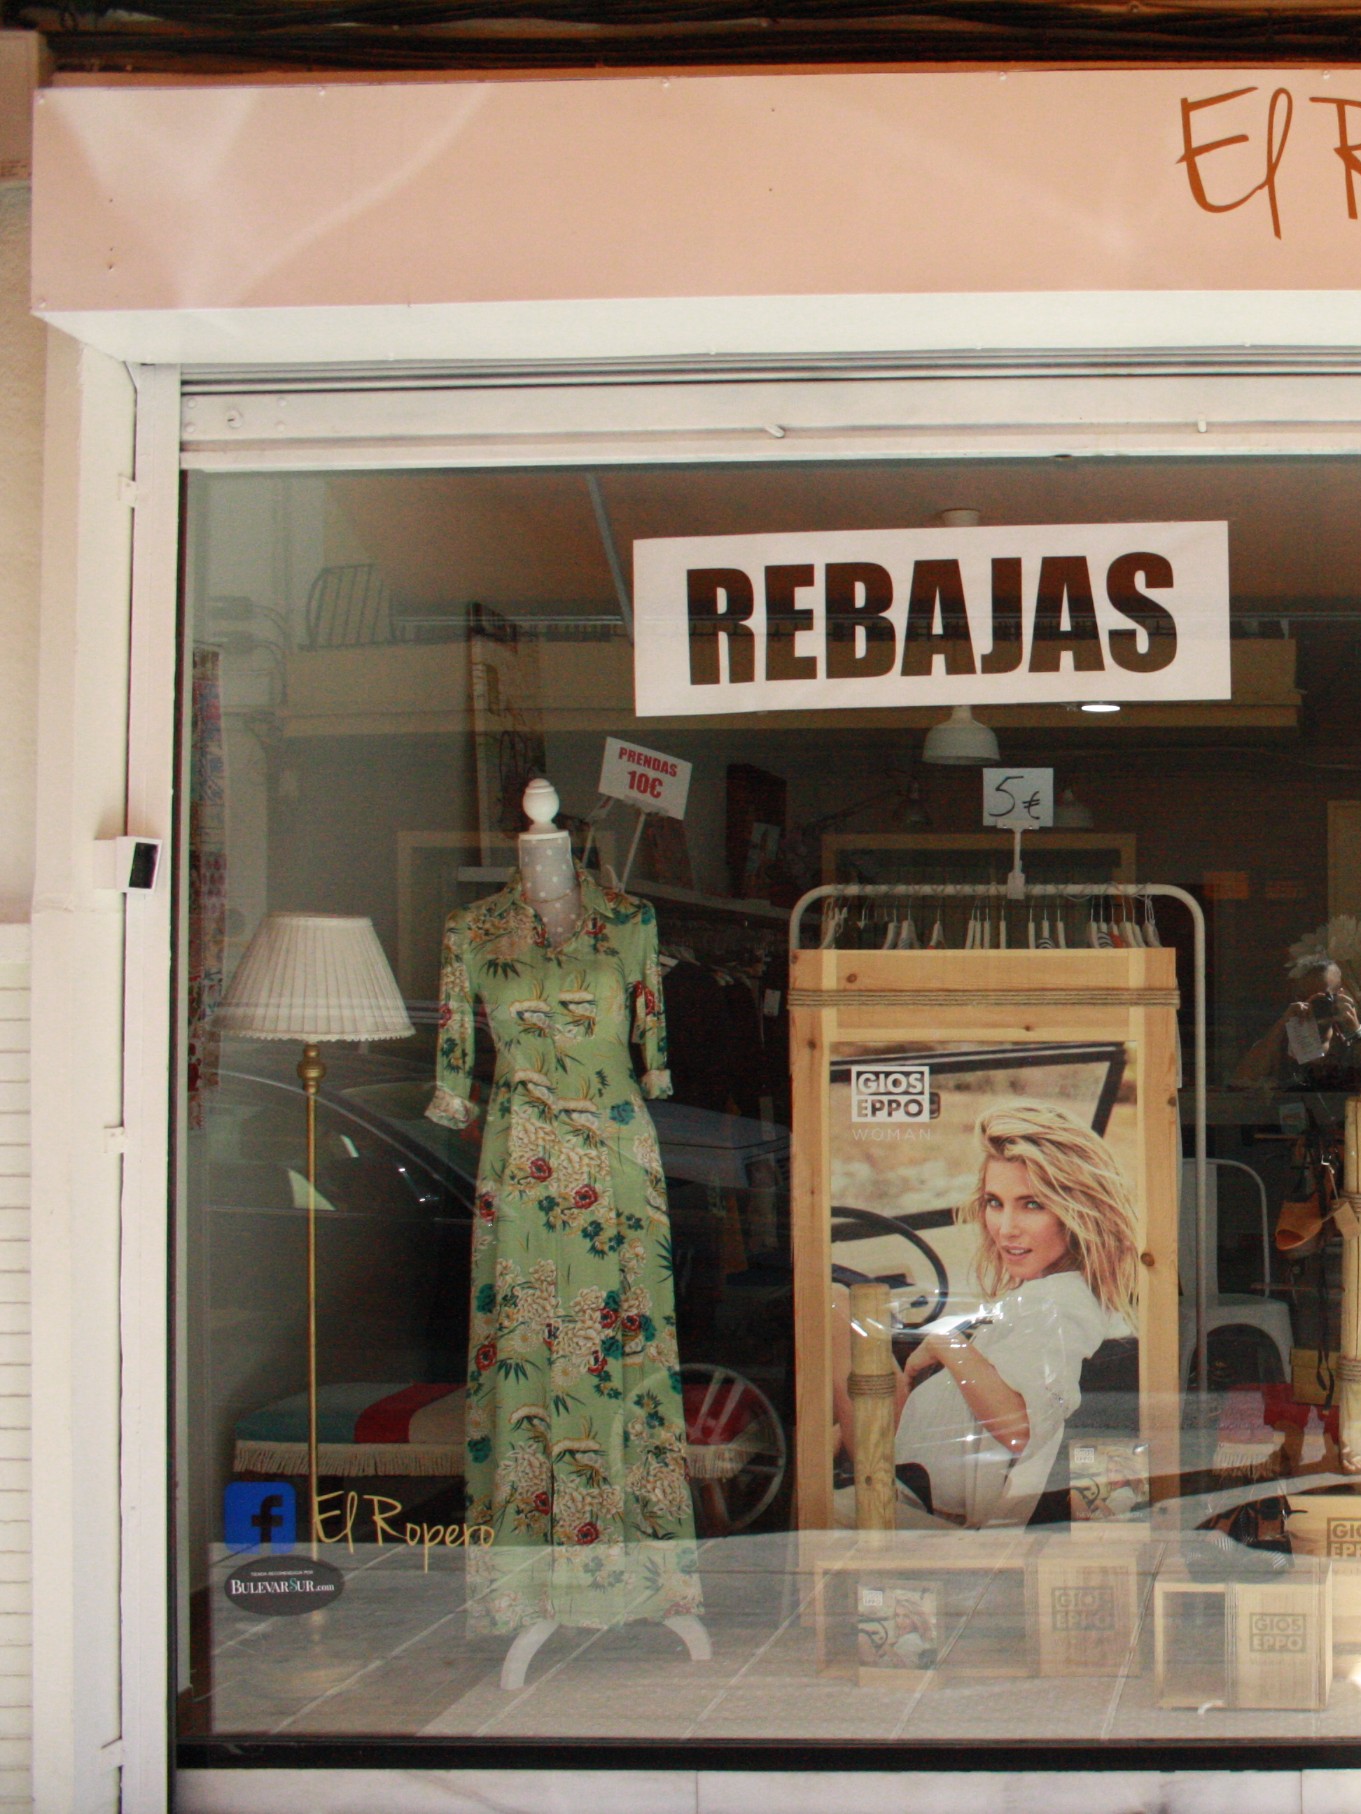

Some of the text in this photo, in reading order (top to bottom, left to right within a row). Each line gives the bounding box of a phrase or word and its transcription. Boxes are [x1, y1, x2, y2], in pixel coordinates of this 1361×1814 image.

[1176, 86, 1293, 240] El
[685, 551, 1178, 686] REBAJAS
[618, 746, 678, 777] PRENDAS
[858, 1072, 923, 1094] GIOS
[857, 1098, 924, 1118] EPPO
[851, 1128, 931, 1141] WOMAN
[314, 1490, 495, 1573] El Ropero
[1254, 1618, 1302, 1632] GIOS
[1253, 1635, 1302, 1650] EPPO
